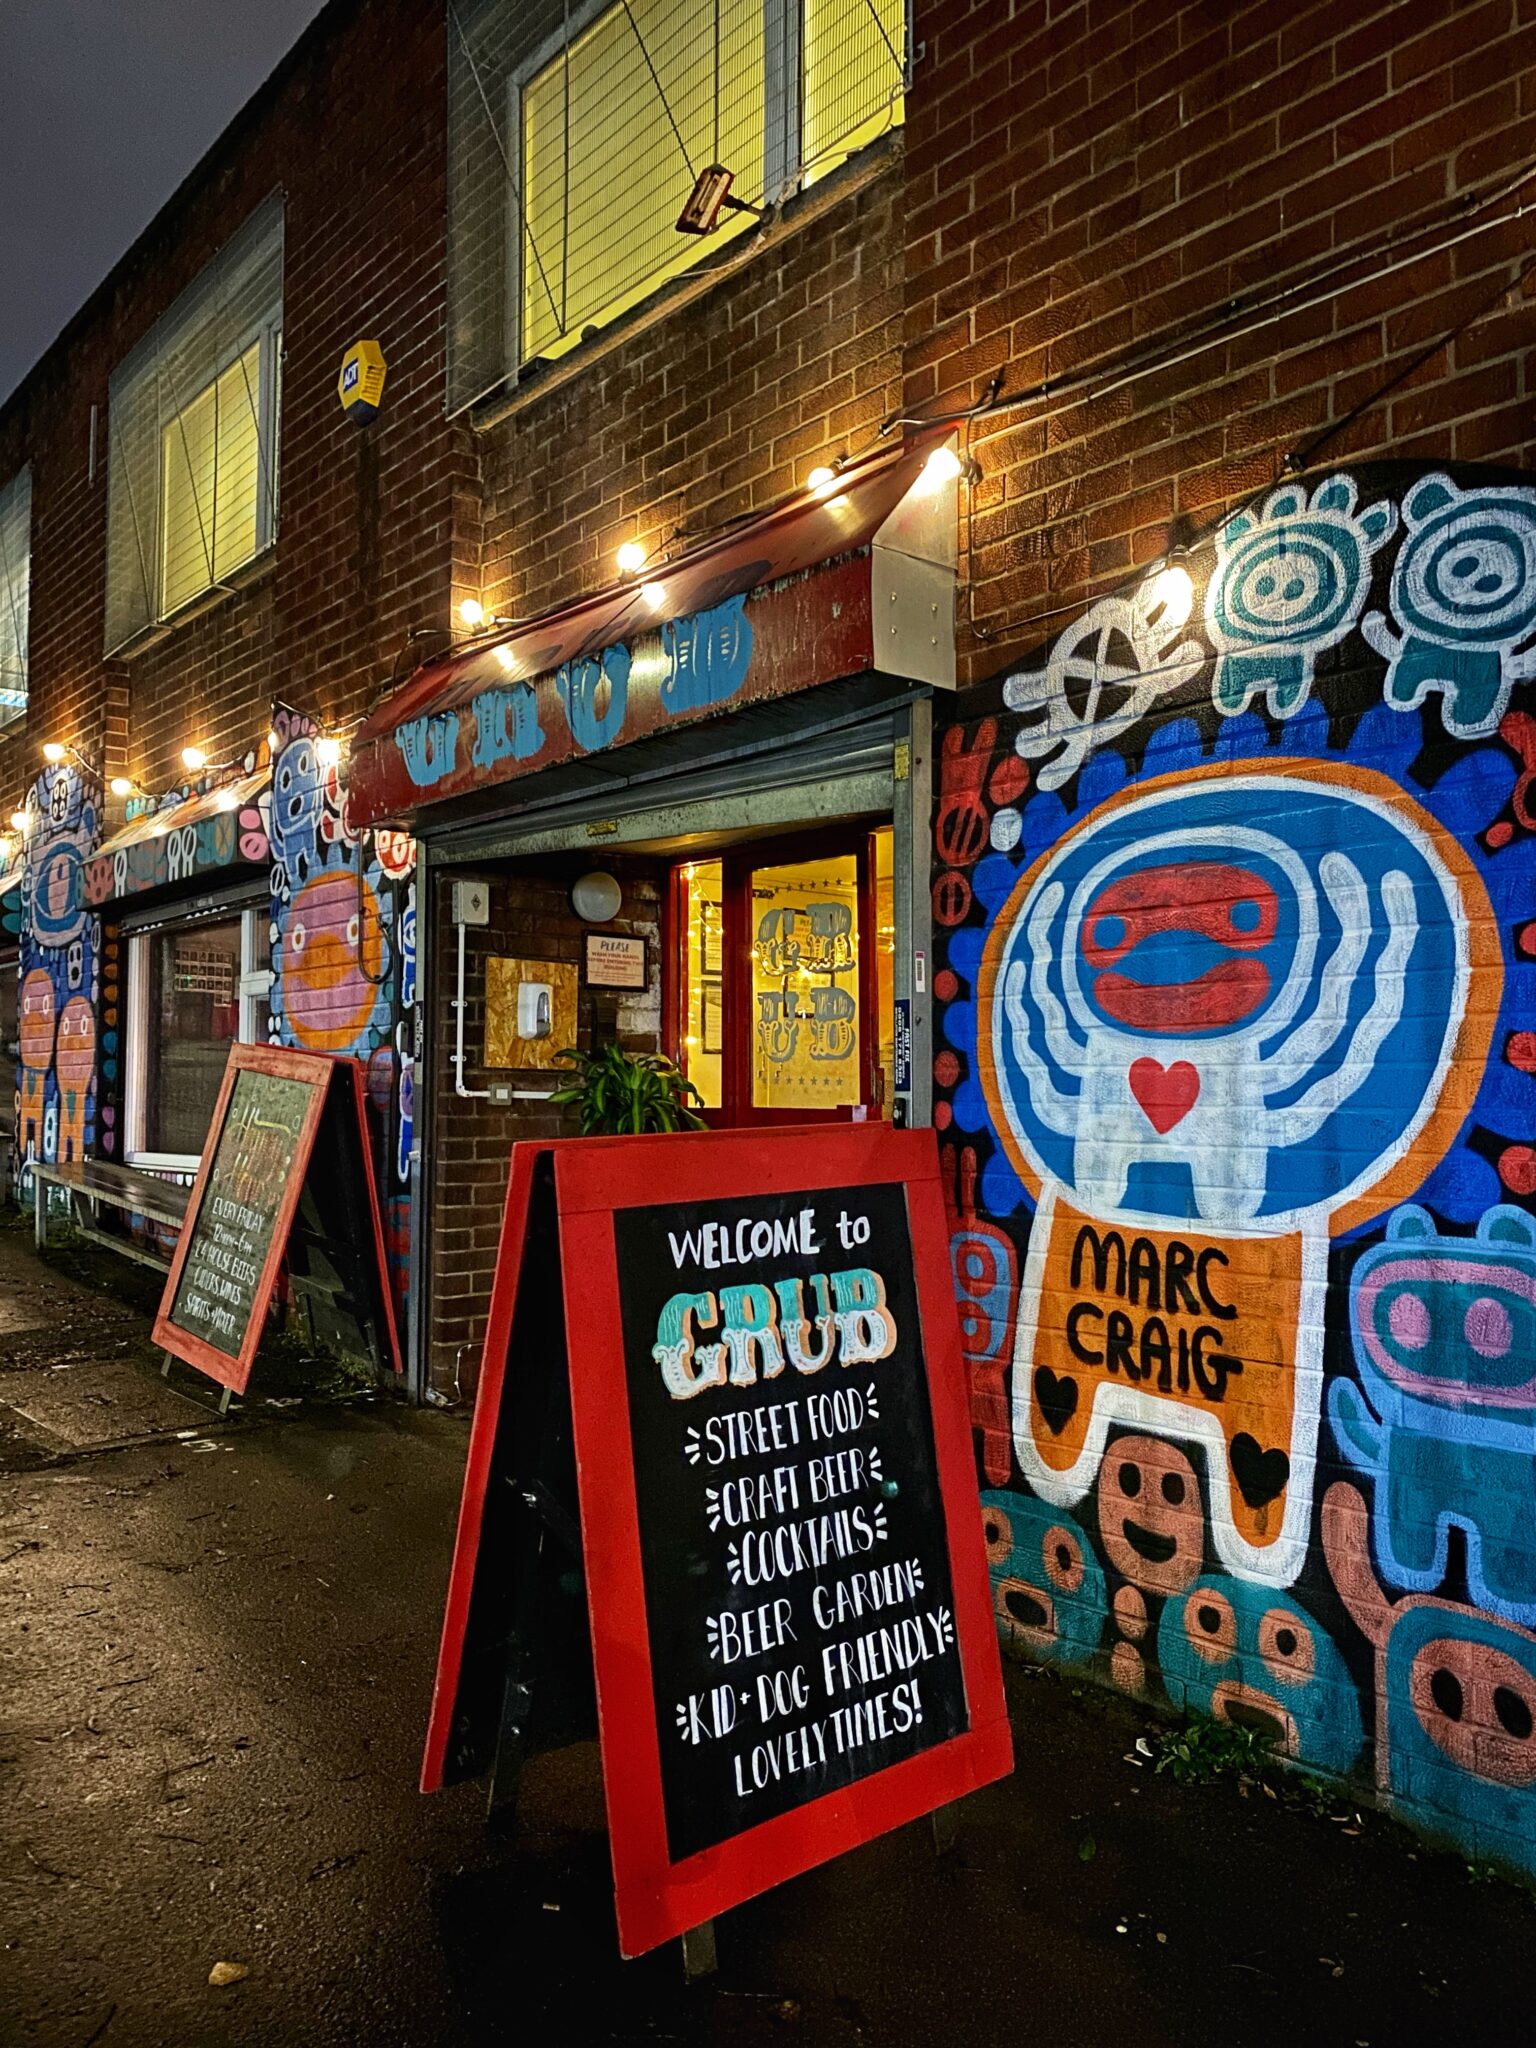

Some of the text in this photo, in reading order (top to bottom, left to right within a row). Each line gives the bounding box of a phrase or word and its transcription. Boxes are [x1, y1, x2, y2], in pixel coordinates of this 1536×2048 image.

[344, 362, 358, 387] ADT
[600, 941, 630, 953] PLEASE
[212, 1197, 266, 1233] EVERY FRIDAY
[668, 1209, 870, 1269] WELCOME to
[207, 1244, 233, 1273] HOUSE
[231, 1257, 256, 1286] BEERS
[1070, 1225, 1238, 1320] MARC
[184, 1293, 211, 1321] SPIRITS
[652, 1268, 897, 1400] GRUB
[1067, 1302, 1243, 1401] CRAIG
[706, 1388, 863, 1465] STREET FOOD
[722, 1448, 869, 1527] CRAFT BEER
[742, 1505, 874, 1586] COCKTAILS
[720, 1560, 916, 1664] BEER GARDEN
[688, 1684, 737, 1745] KID
[757, 1665, 810, 1723] DOG
[822, 1605, 946, 1696] FRIENDLY
[734, 1679, 923, 1797] LOVELY TIMES!
